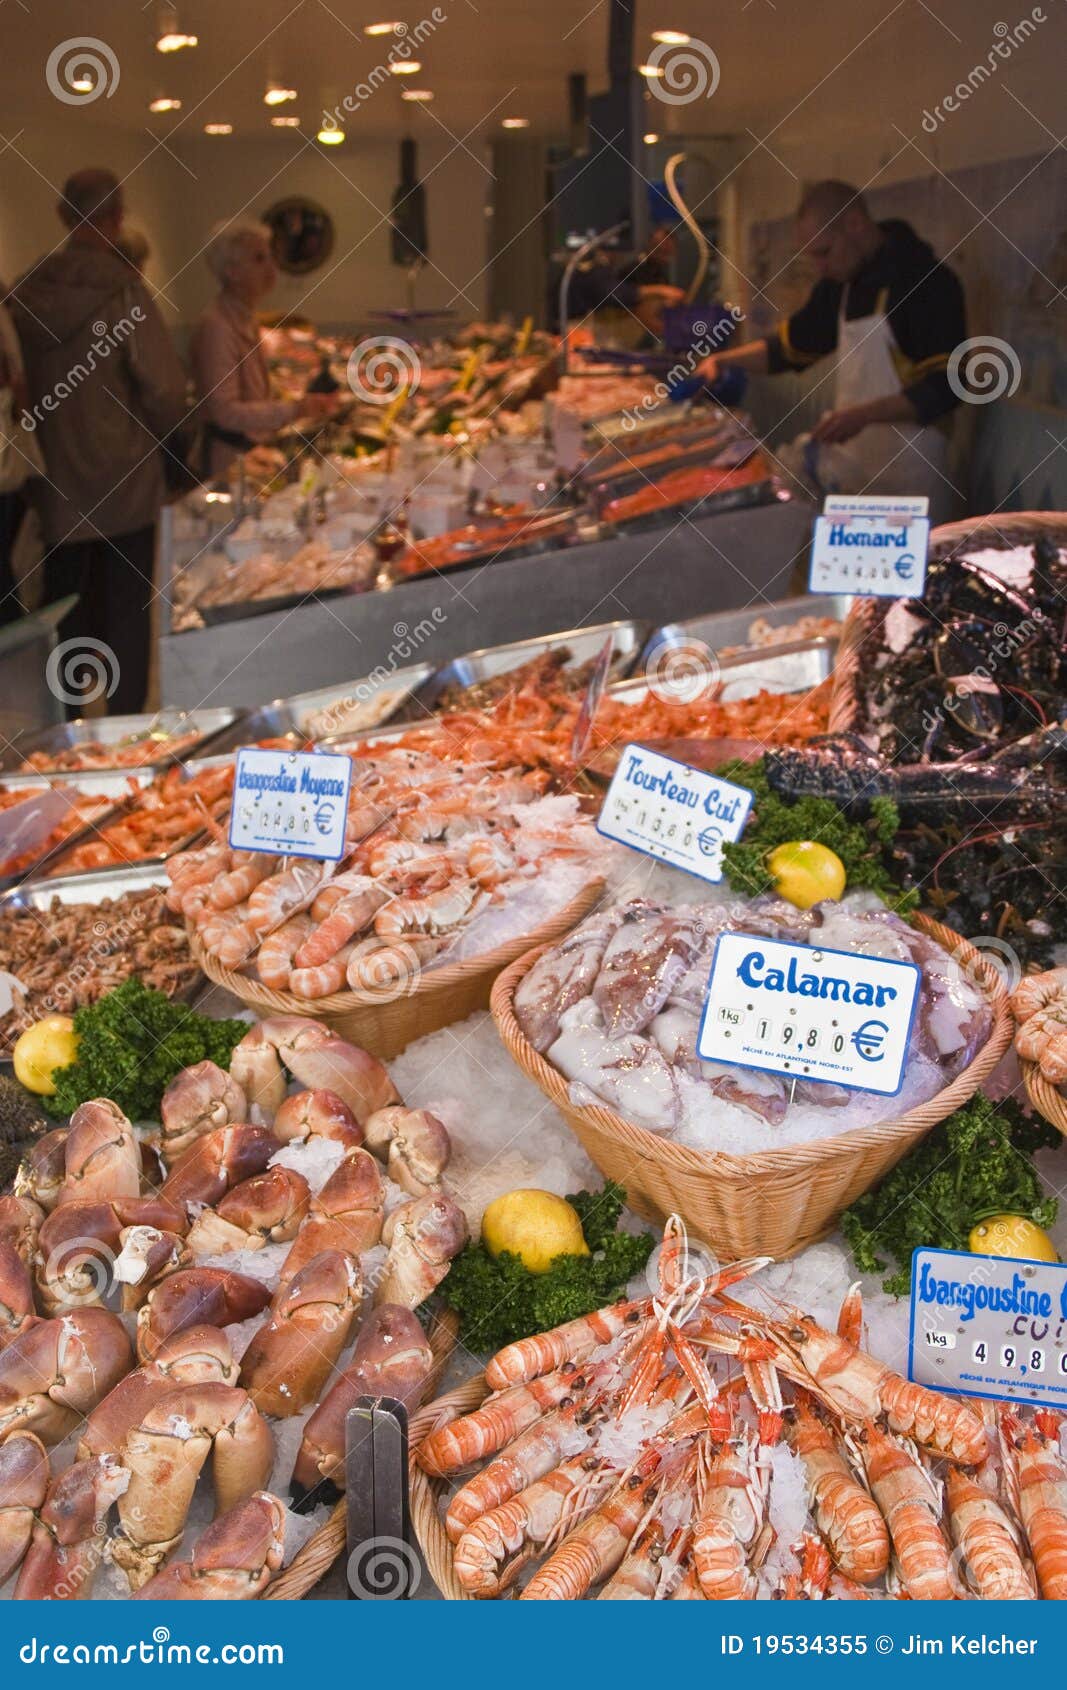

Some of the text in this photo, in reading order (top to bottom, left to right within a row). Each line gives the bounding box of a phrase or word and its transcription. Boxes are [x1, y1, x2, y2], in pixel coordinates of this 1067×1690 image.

[828, 524, 908, 547] Homard
[299, 766, 345, 805] Moyenne
[625, 755, 741, 823] Tourteau Cuit
[736, 951, 898, 1008] Calamar
[721, 1009, 740, 1024] 1kg
[776, 1053, 817, 1064] ATLANTIQUE
[819, 1061, 854, 1072] NORD-EST
[919, 1263, 1052, 1322] Langoustine
[926, 1332, 947, 1346] 1kg
